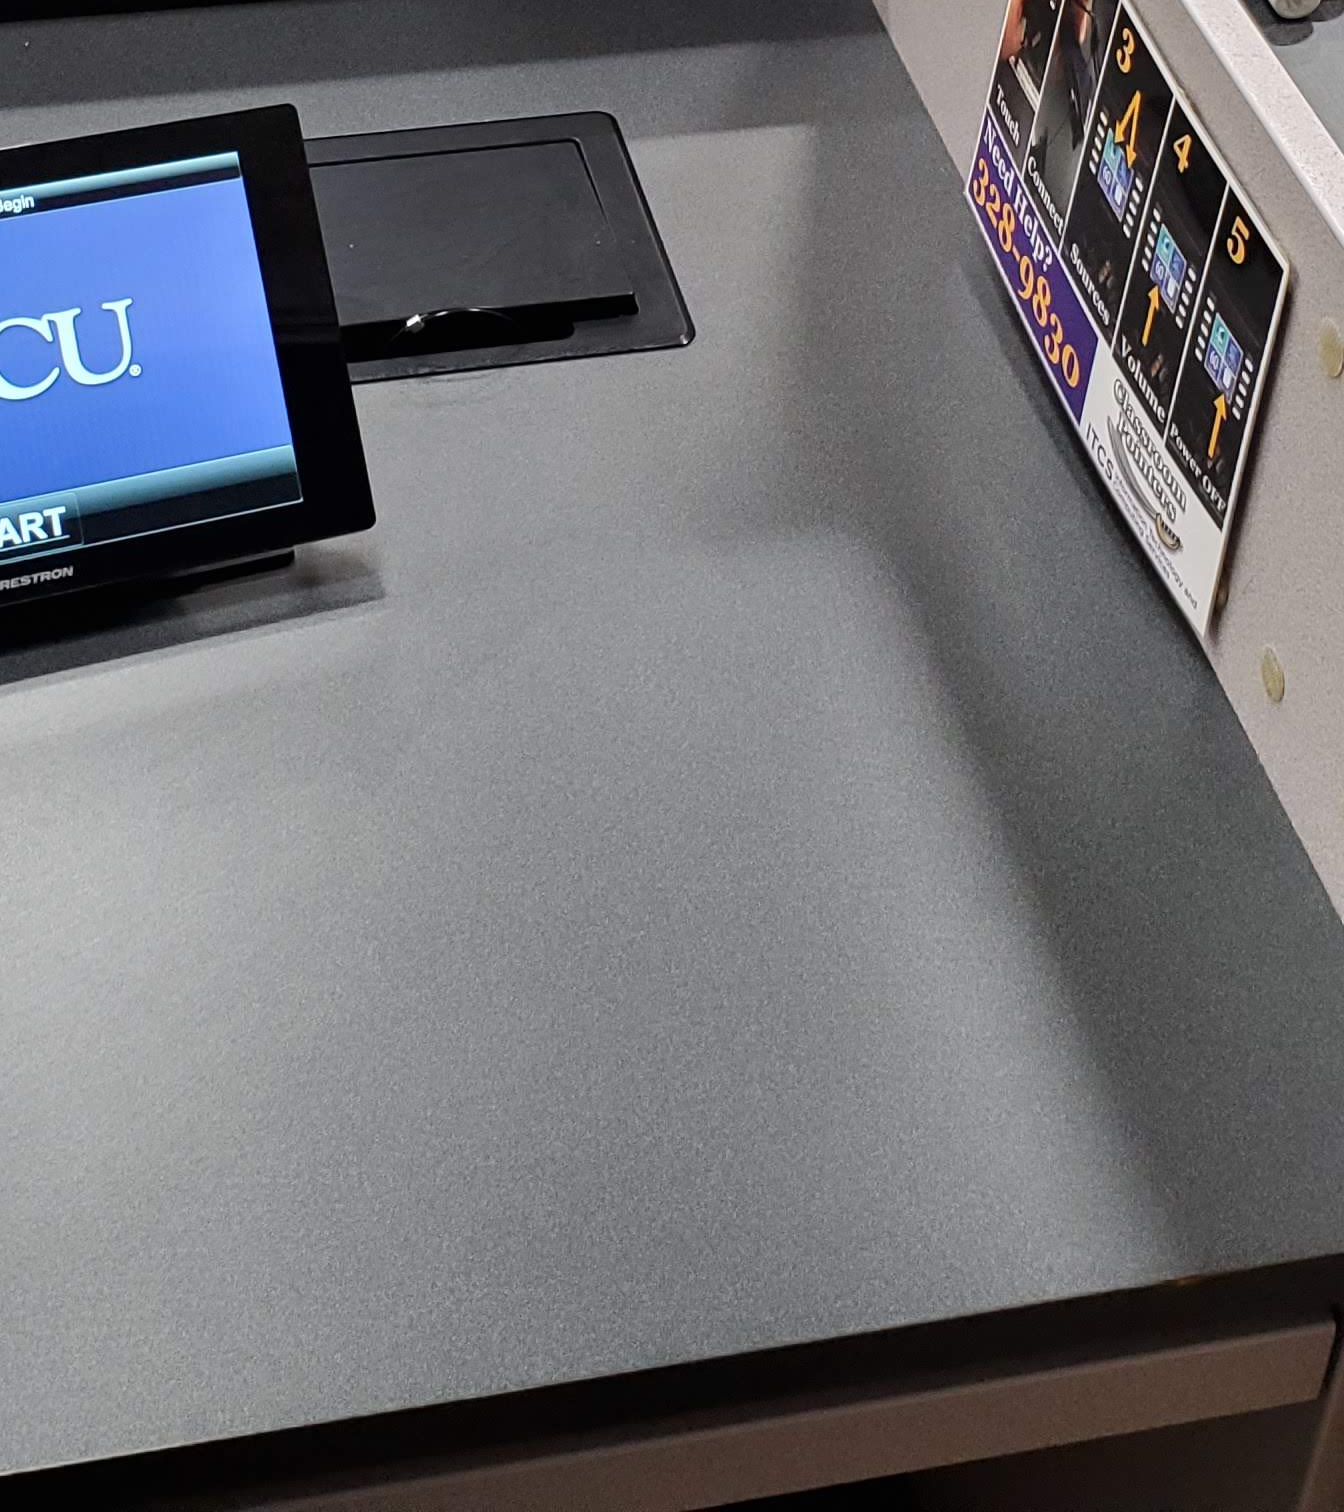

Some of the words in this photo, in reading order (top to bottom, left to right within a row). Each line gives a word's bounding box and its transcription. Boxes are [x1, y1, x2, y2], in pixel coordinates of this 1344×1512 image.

[1116, 27, 1135, 74] 3
[994, 84, 1021, 148] Touch
[1172, 132, 1193, 173] 4
[982, 120, 1015, 197] Need
[1013, 186, 1053, 275] Help?
[1026, 154, 1065, 239] Connect
[972, 157, 1080, 389] 328-9830
[1226, 216, 1250, 265] 5
[1068, 242, 1111, 329] Sources
[1118, 334, 1166, 426] Volume
[1085, 425, 1115, 481] ITCS
[1112, 376, 1188, 512] Classroom
[1116, 411, 1177, 525] Pointers
[1169, 421, 1203, 483] Power
[1202, 474, 1227, 520] OFF
